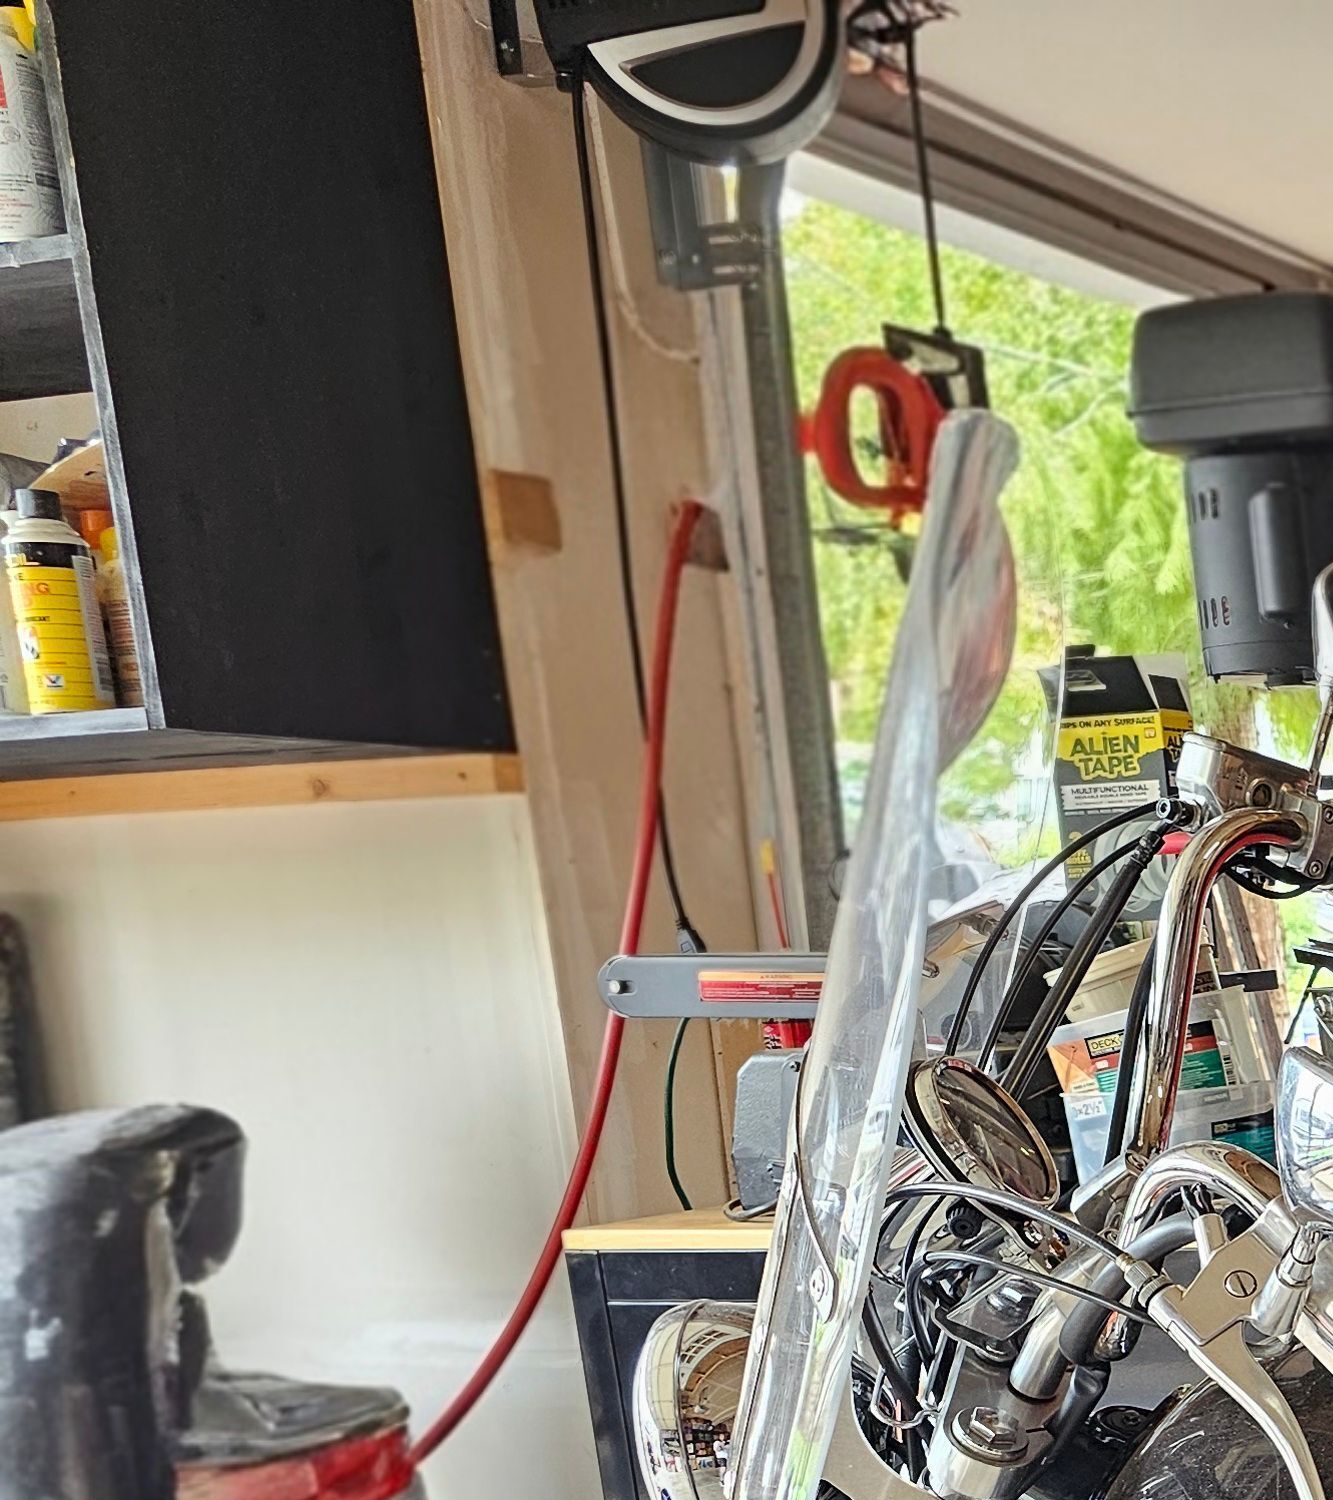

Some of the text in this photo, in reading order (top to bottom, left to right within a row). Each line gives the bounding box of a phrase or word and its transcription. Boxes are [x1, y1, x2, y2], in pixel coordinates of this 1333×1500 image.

[1079, 720, 1092, 728] ON
[1094, 719, 1111, 728] ANY
[1079, 754, 1137, 777] TAPE
[1071, 784, 1149, 795] MULTIFUNCTIONAL
[1091, 1037, 1118, 1050] DECK
